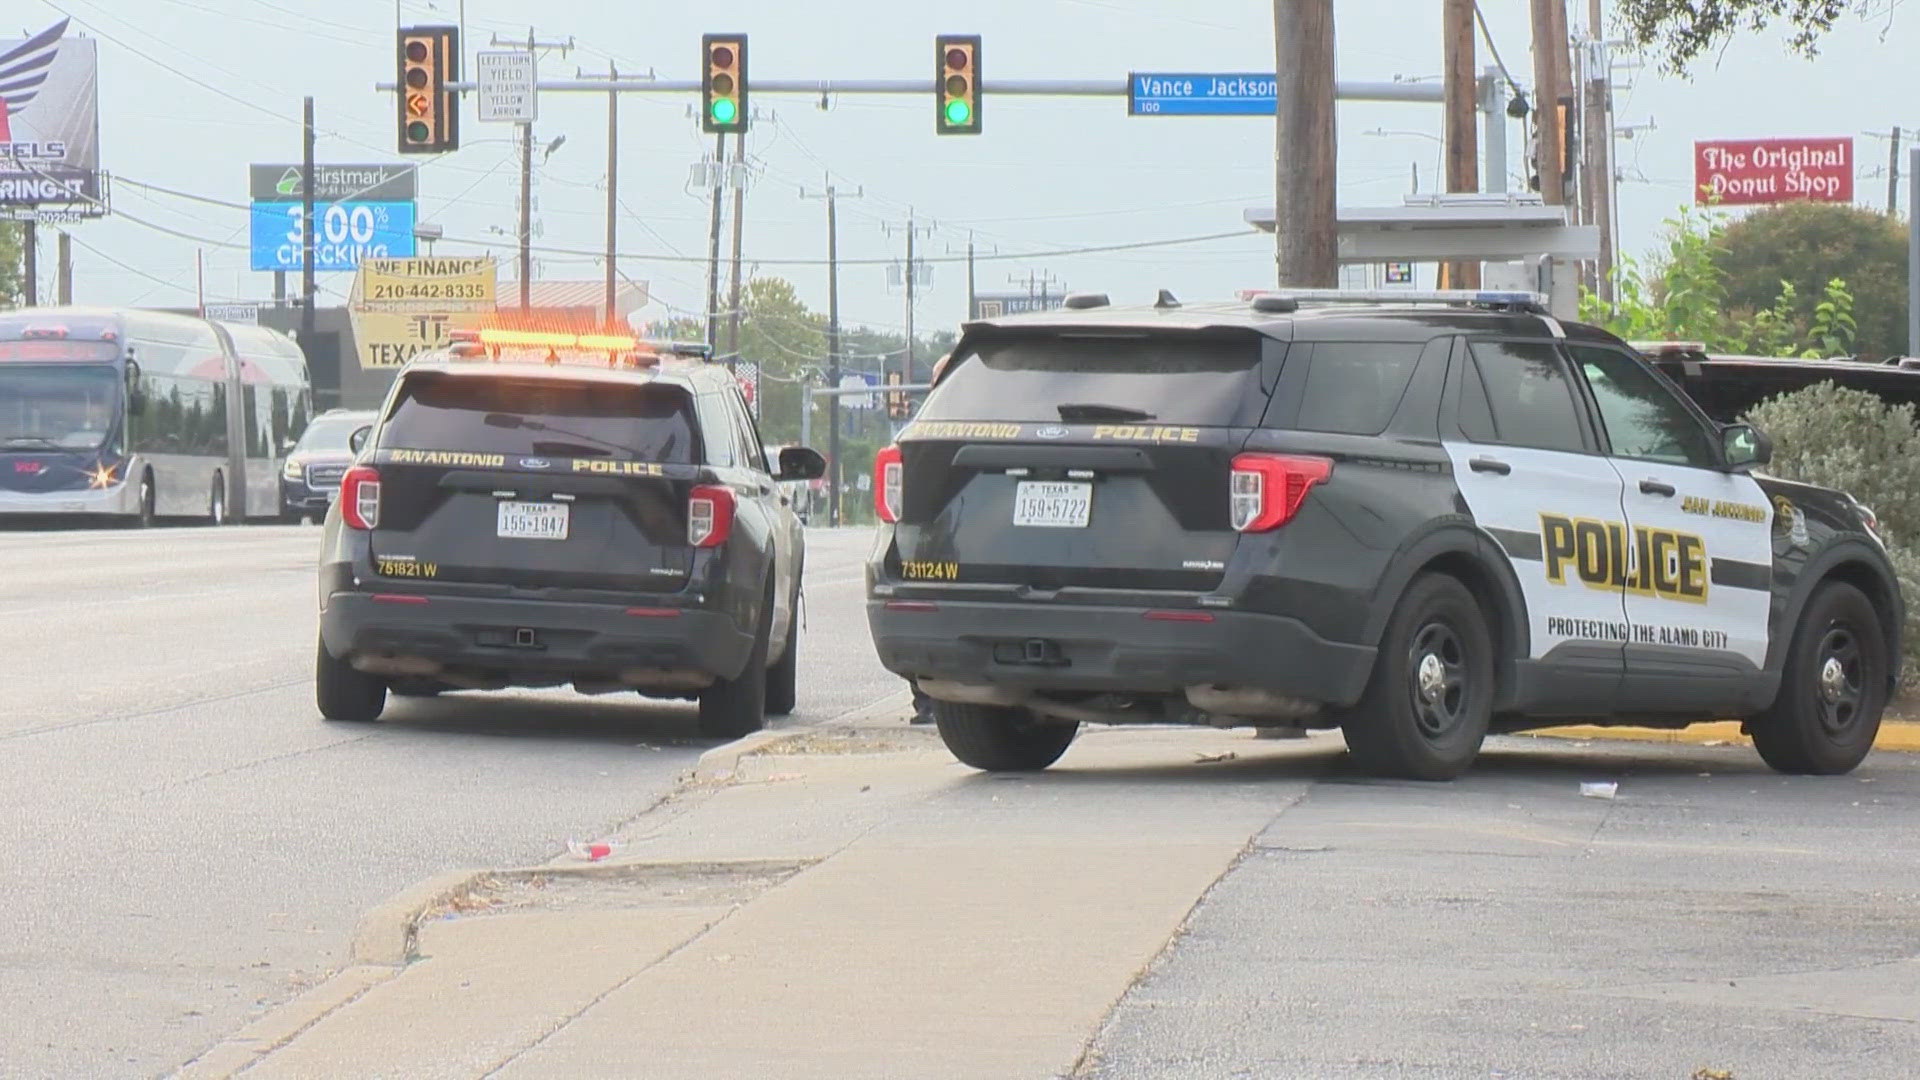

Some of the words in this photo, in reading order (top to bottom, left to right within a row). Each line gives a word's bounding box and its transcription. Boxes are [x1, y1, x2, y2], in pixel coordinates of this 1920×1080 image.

[481, 56, 501, 66] LEFT
[508, 56, 530, 66] TURN
[490, 69, 523, 80] YIELD
[1141, 77, 1193, 96] Vance
[1207, 77, 1277, 96] Jackson
[491, 95, 522, 105] YELLOW
[1142, 103, 1160, 112] 100
[493, 107, 521, 116] ARROW
[1703, 147, 1746, 172] The
[1753, 143, 1845, 172] Original
[1710, 173, 1777, 196] Donut
[1785, 171, 1840, 197] Shop
[276, 244, 389, 265] CHCKING
[375, 261, 400, 275] WE
[408, 260, 483, 276] FINANCE
[375, 284, 485, 299] 210-442-8335
[1093, 425, 1199, 442] POLICE
[391, 449, 422, 462] SAN
[424, 451, 505, 466] ANTONIO
[572, 459, 663, 476] POLICE
[1041, 485, 1069, 493] TEXAS
[521, 505, 548, 513] TEXAS
[1538, 512, 1708, 605] POLICE
[424, 562, 437, 577] W
[901, 560, 942, 578] 731124
[945, 562, 958, 579] W
[1548, 616, 1627, 640] PROTECTING
[1633, 623, 1656, 643] THE
[1659, 626, 1699, 646] ALAMO
[1702, 630, 1728, 649] CITY
